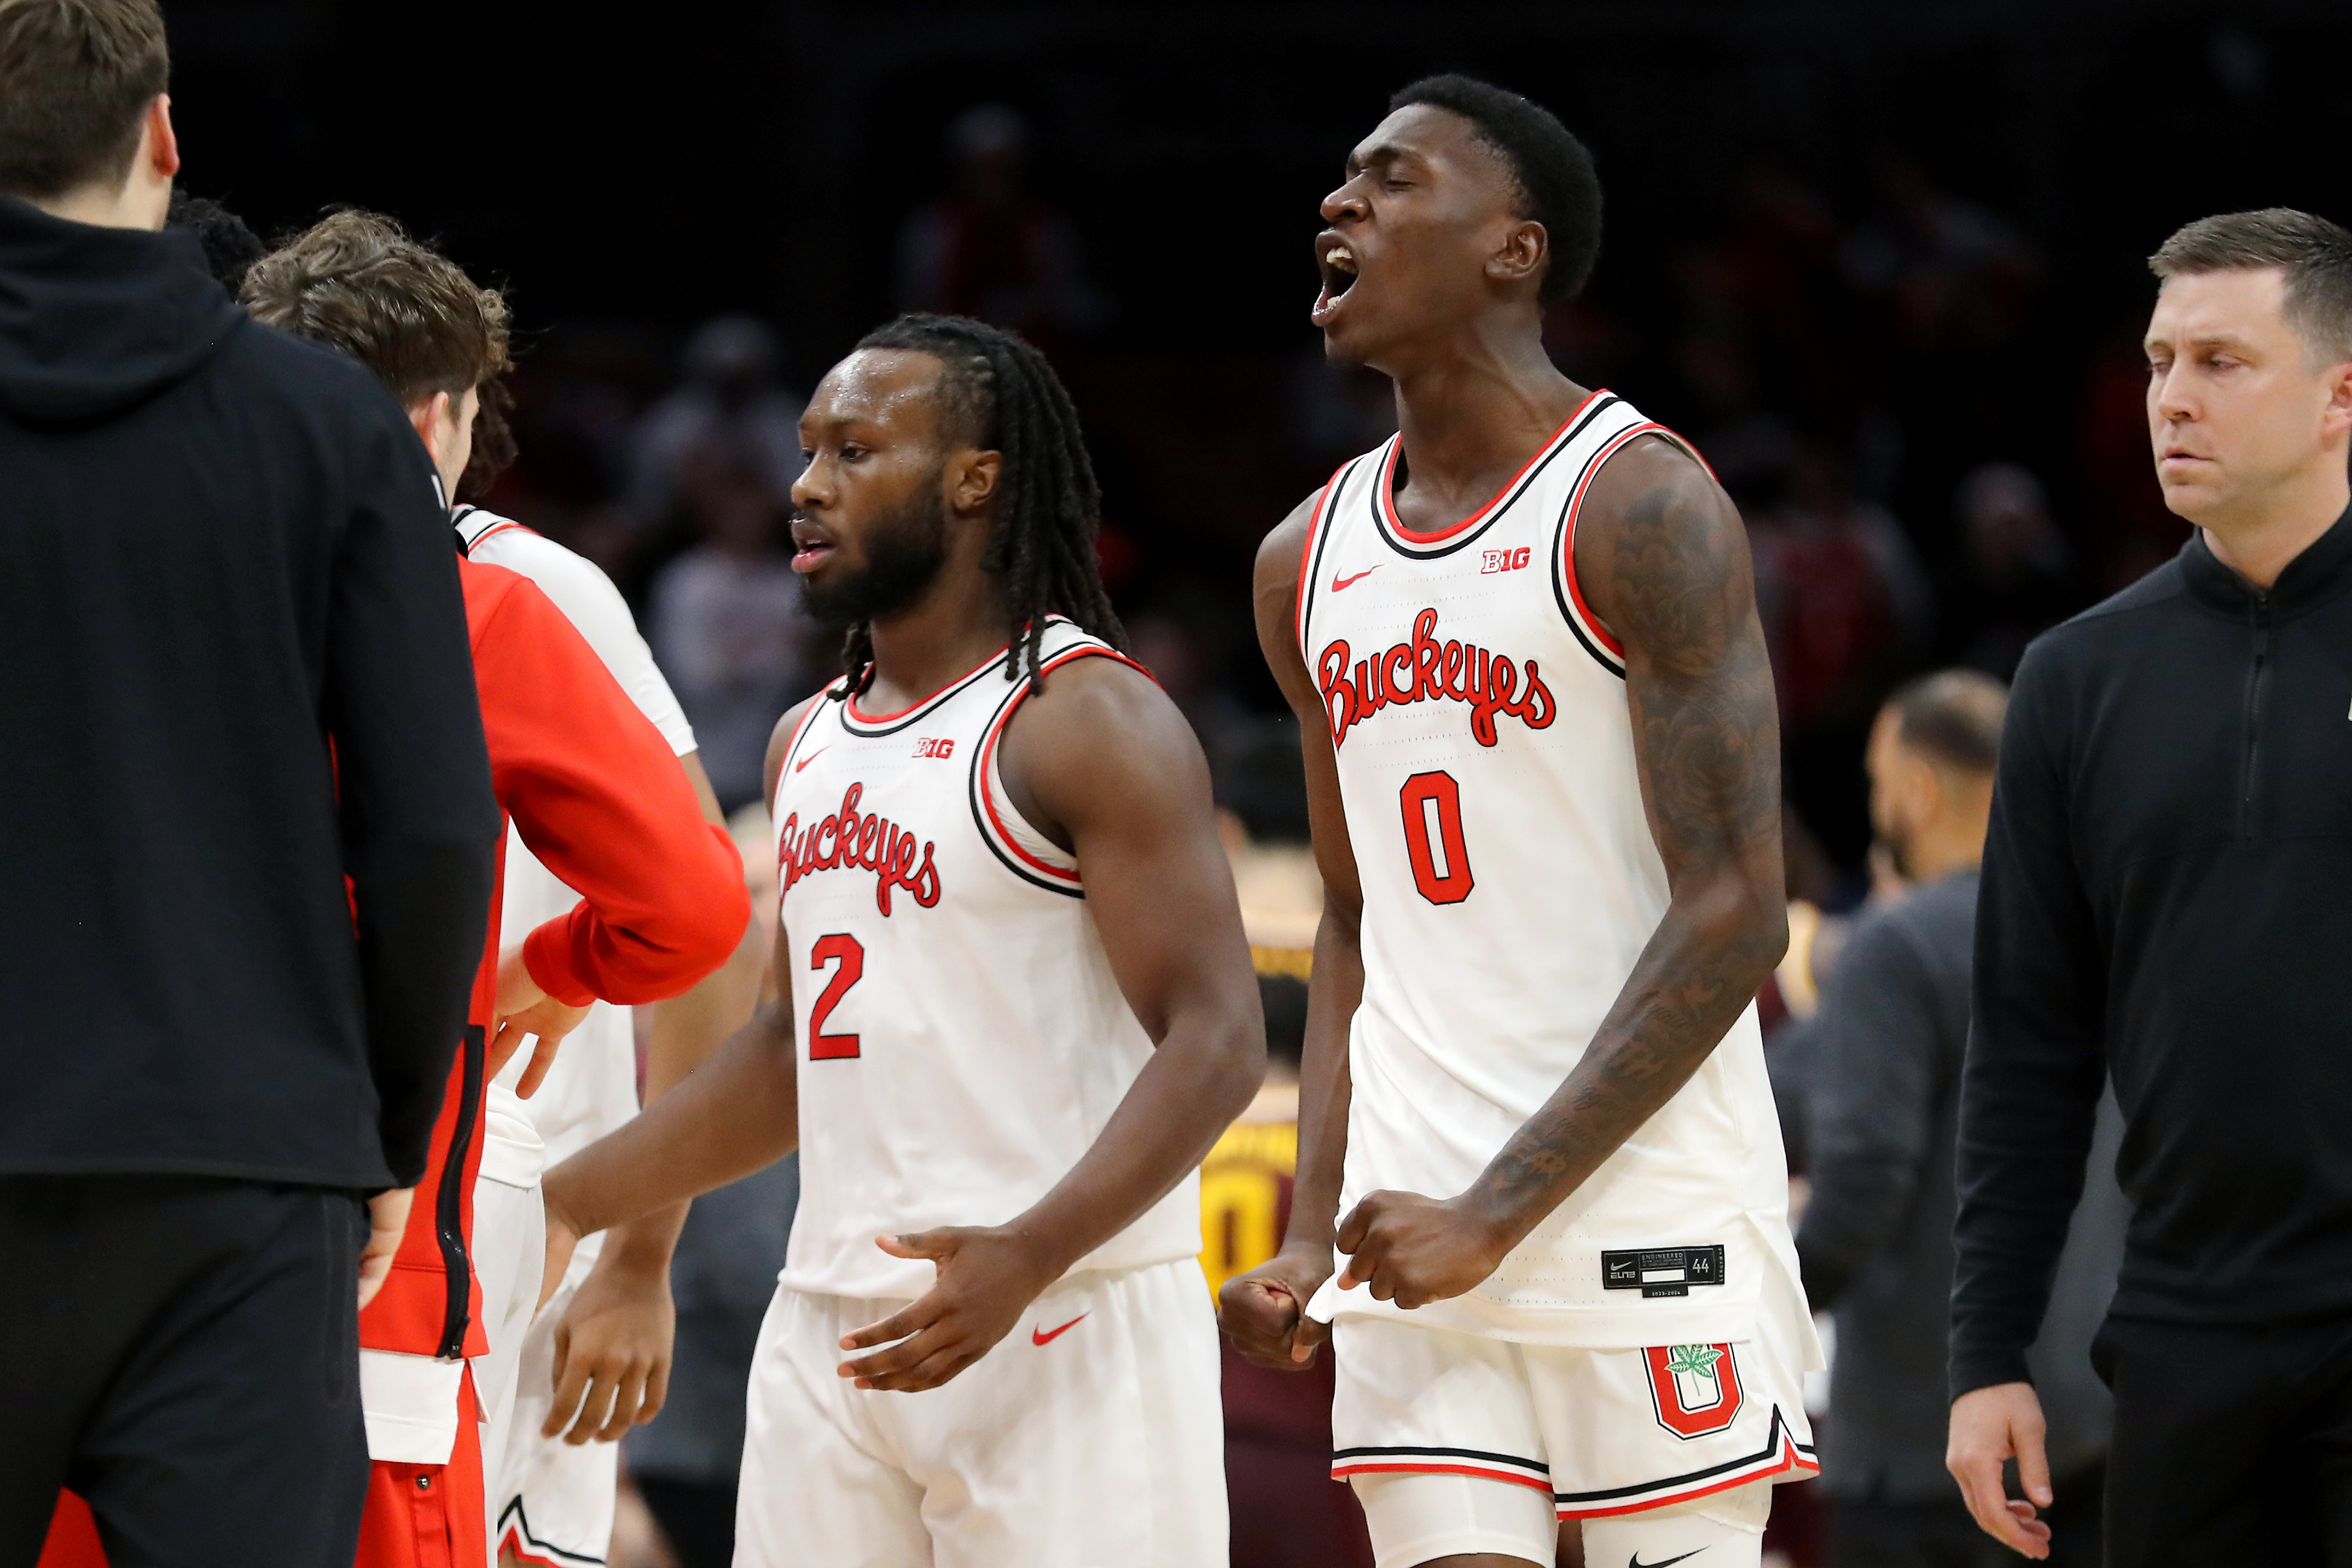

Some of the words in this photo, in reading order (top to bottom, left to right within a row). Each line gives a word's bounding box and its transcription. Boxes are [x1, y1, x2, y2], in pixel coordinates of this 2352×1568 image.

[1318, 608, 1556, 752] Buckeyes
[779, 782, 941, 917] Buckeyes
[1400, 770, 1475, 906] 0
[809, 933, 864, 1061] 2
[1692, 1258, 1710, 1273] 44
